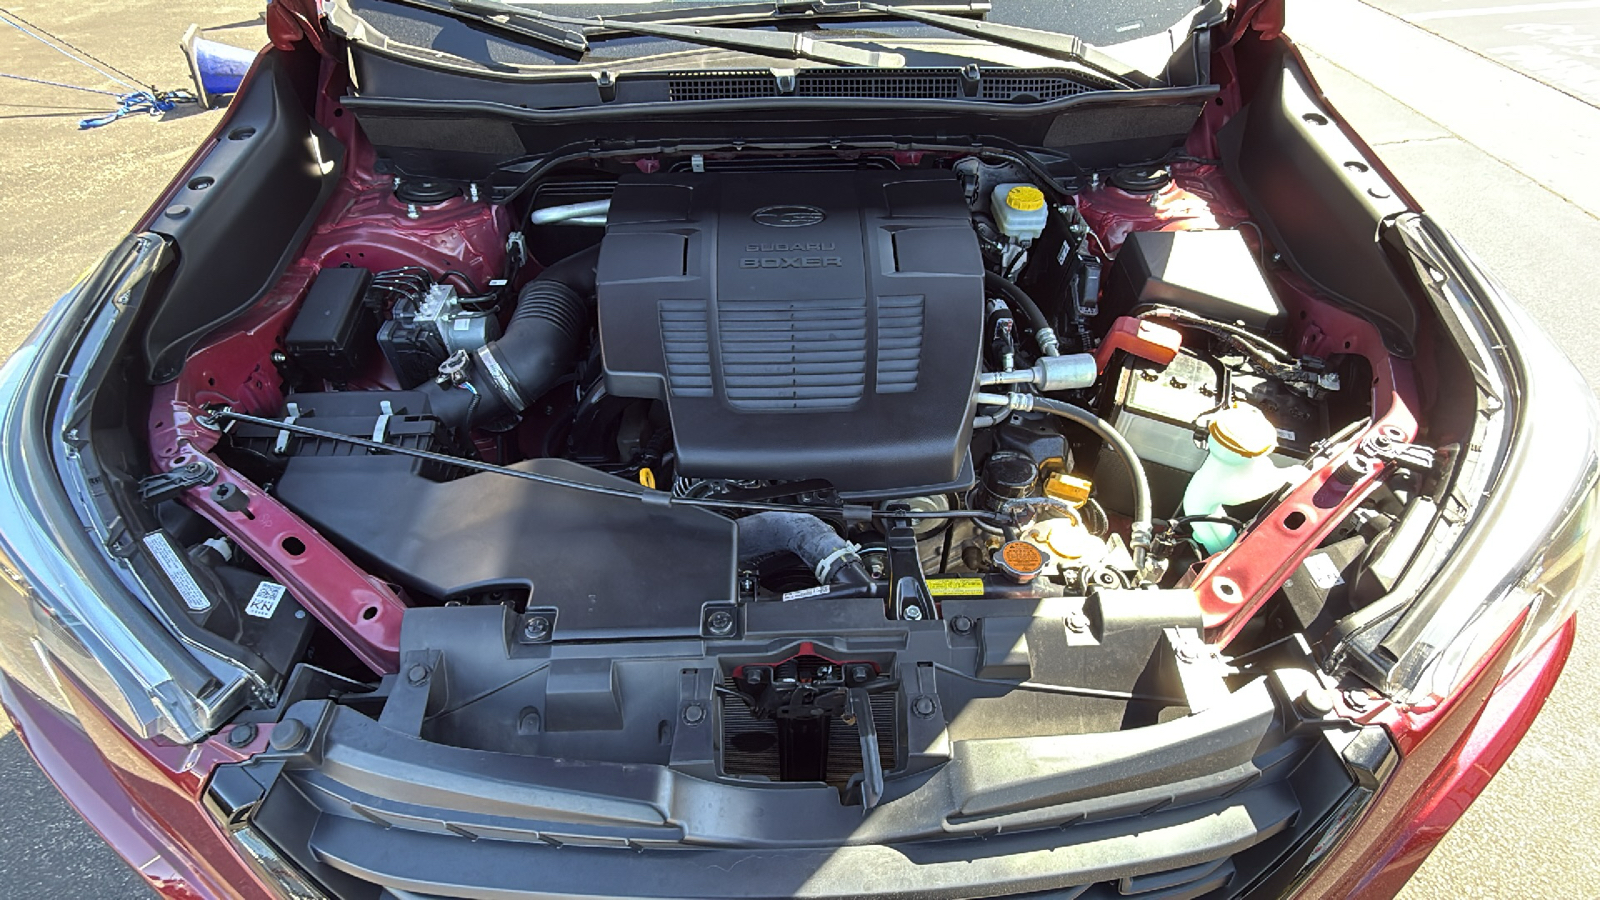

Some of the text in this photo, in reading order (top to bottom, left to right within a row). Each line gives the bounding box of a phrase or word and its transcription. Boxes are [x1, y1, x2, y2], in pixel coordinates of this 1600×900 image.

[745, 242, 835, 252] SUBARU
[739, 256, 842, 268] BOXER
[250, 600, 273, 611] KN
